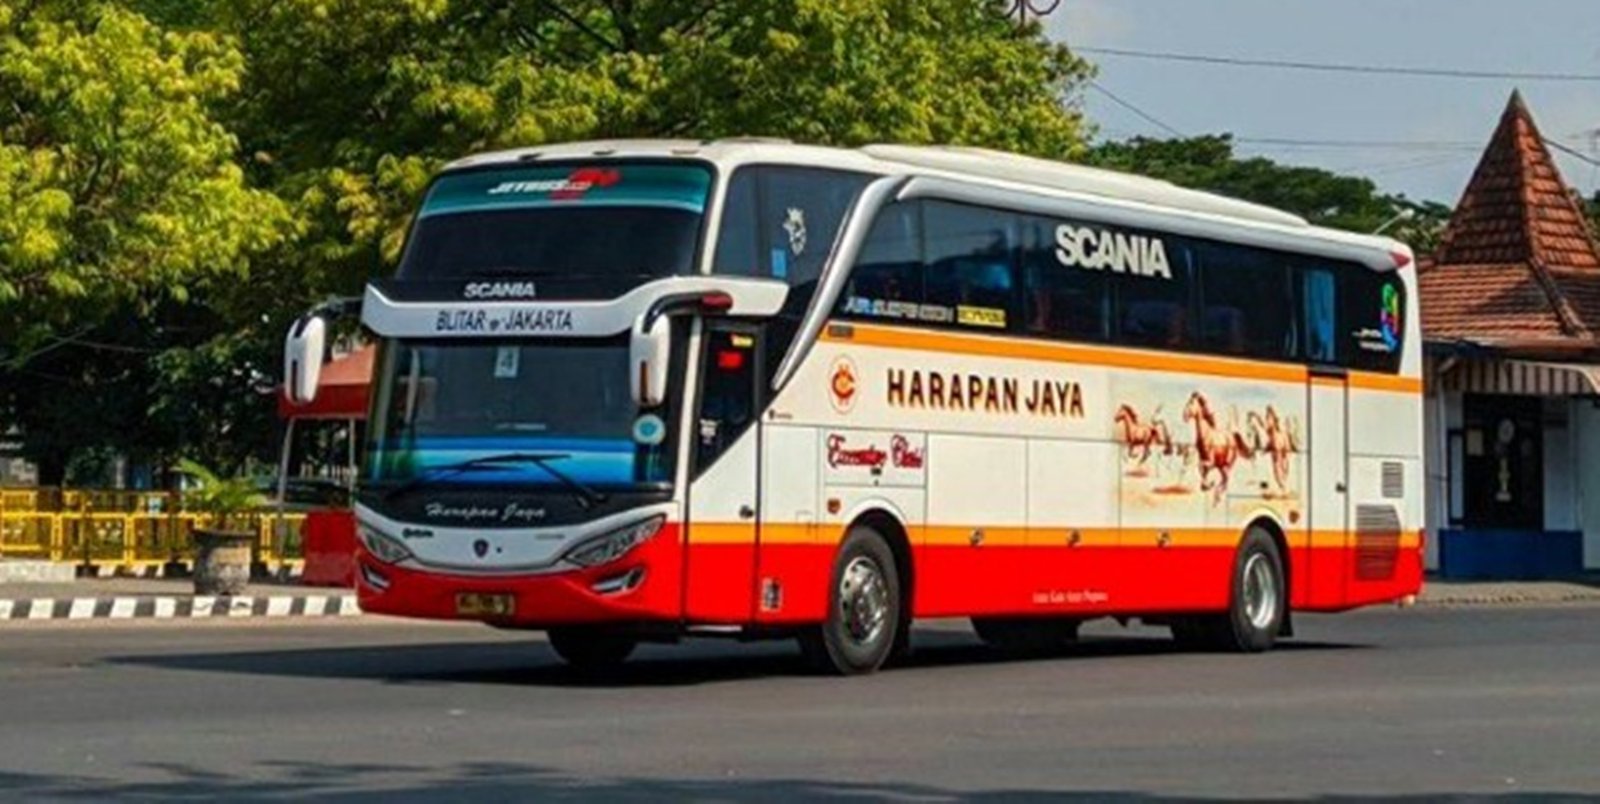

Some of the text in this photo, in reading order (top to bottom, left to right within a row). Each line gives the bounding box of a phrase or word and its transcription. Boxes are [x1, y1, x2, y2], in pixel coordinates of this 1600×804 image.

[1055, 224, 1172, 279] SCANIA
[464, 281, 536, 299] SCANIA
[436, 308, 573, 331] BLITAR JAKARTA
[887, 367, 1085, 419] HARAPAN JAYA
